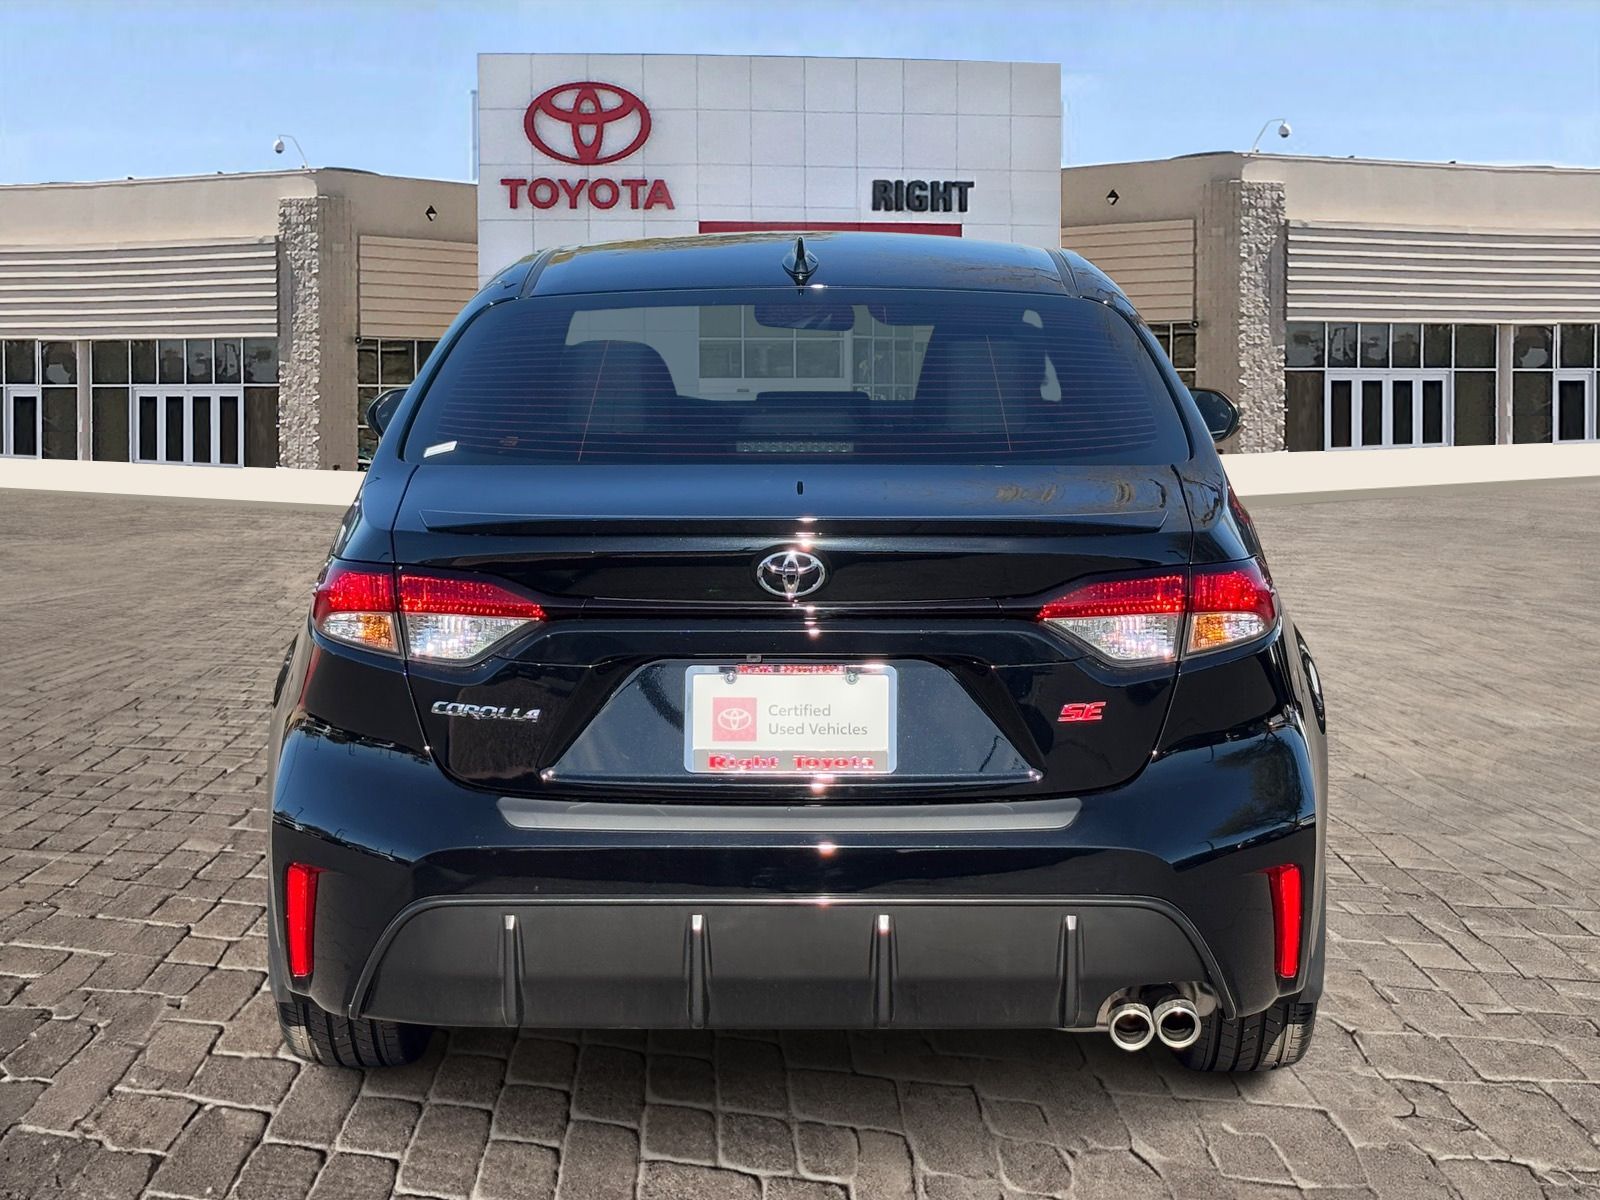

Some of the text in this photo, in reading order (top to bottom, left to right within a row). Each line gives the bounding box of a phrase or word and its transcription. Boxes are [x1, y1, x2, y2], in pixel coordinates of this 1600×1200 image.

[500, 178, 675, 211] TOYOTA
[871, 179, 975, 213] RIGHT
[431, 701, 541, 723] COROLLA
[768, 703, 831, 717] Certified
[1057, 701, 1107, 722] SE
[768, 722, 868, 735] Used Vehicles
[708, 754, 876, 771] Right Toyota
